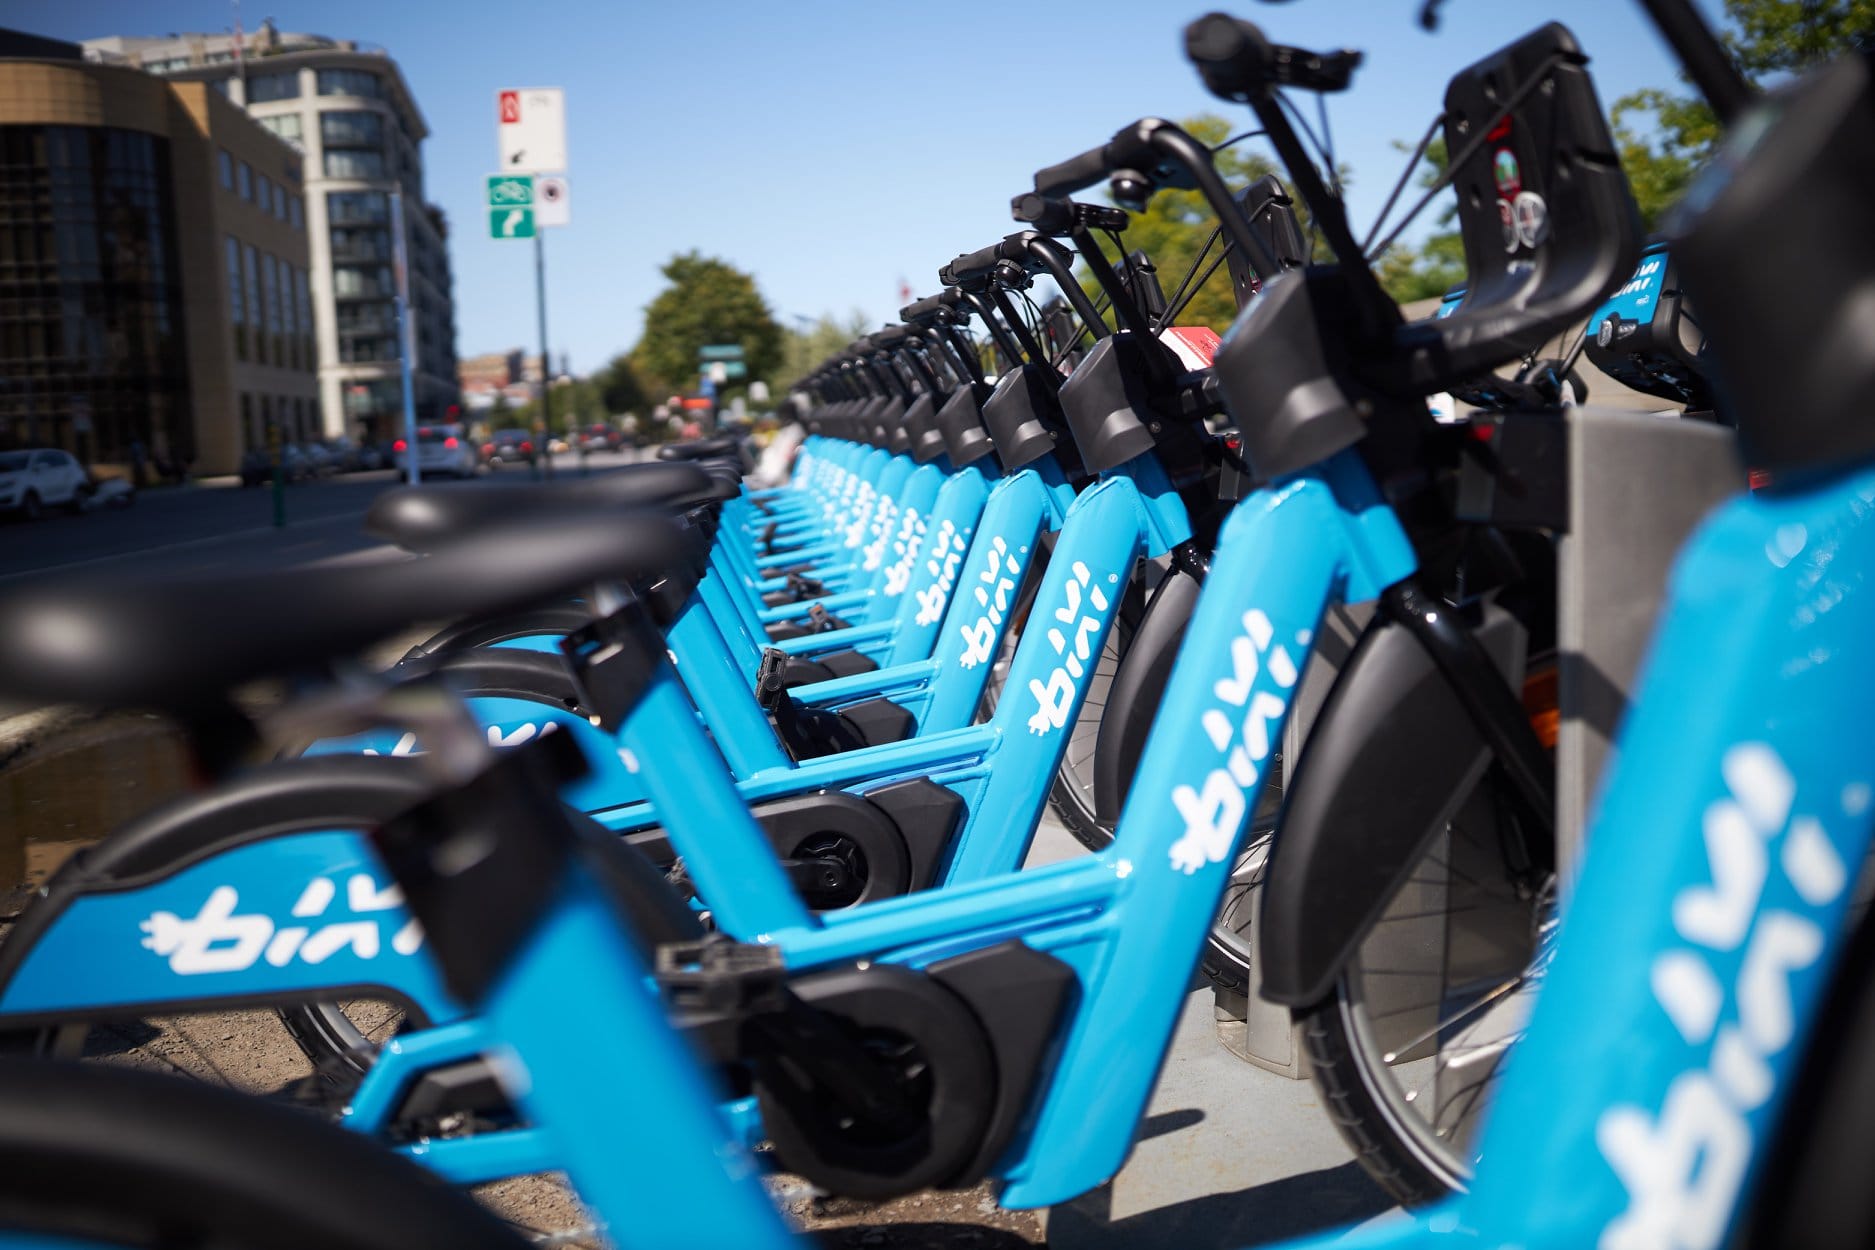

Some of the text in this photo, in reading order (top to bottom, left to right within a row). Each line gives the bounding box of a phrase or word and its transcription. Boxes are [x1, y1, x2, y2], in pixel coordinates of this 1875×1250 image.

[915, 519, 966, 626] bixi
[959, 535, 1020, 669] bixi
[1028, 561, 1108, 736] bixi
[1168, 608, 1298, 875] bixi
[1596, 742, 1846, 1249] bixi
